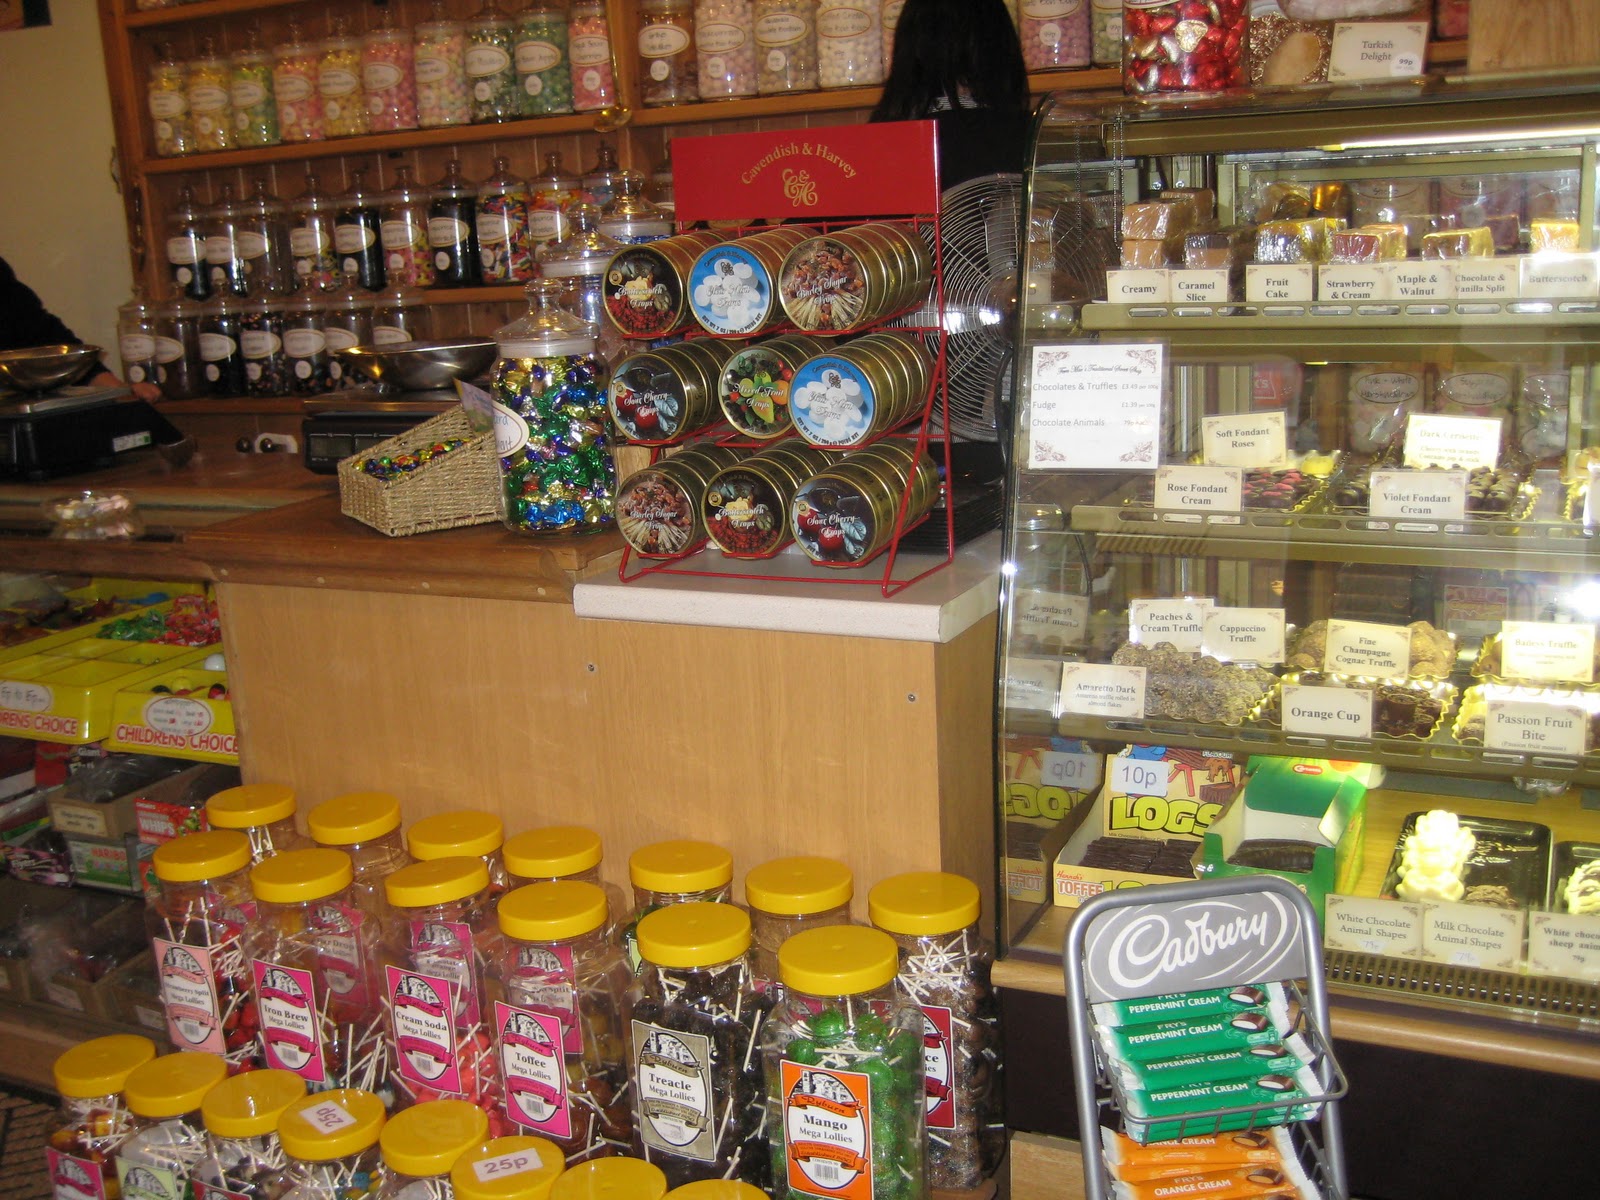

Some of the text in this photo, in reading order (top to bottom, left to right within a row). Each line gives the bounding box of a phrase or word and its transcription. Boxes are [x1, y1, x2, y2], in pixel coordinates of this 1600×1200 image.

[1362, 40, 1393, 49] Turkish
[1360, 51, 1392, 62] Delight
[1398, 58, 1413, 66] 99p
[741, 142, 857, 185] Cavendish & Harvey
[1266, 278, 1288, 287] Fruit
[1397, 275, 1437, 285] Maple &
[1455, 274, 1505, 283] Chocolate &
[1529, 274, 1588, 284] Butterscotch
[617, 284, 664, 297] Butterscotch
[796, 276, 848, 299] Barley Sugar
[1122, 285, 1157, 294] Creamy
[1178, 281, 1215, 290] Caramel
[1326, 280, 1375, 290] Strawberry
[1400, 287, 1435, 295] Walnut
[1455, 284, 1505, 293] Vanilla Split
[1186, 292, 1206, 301] Slice
[1266, 290, 1288, 298] Cake
[1341, 291, 1371, 299] Cream
[629, 298, 654, 309] Drops
[731, 384, 785, 398] Mixed Fruit
[1033, 382, 1076, 391] Chocolates
[1078, 383, 1085, 391] &
[1087, 382, 1117, 391] Truffles
[643, 391, 668, 403] Cherry
[746, 397, 771, 409] Drops
[1032, 401, 1056, 410] Fudge
[1032, 418, 1105, 427] Chocolate Animals
[1216, 428, 1270, 438] Soft Fondant
[1231, 440, 1255, 448] Roses
[1167, 483, 1228, 493] Rose Fondant
[1181, 496, 1212, 505] Cream
[1383, 492, 1451, 503] Violet Fondant
[630, 509, 678, 521] Barley Sugar
[718, 507, 765, 518] Butterscotch
[1400, 505, 1432, 514] Cream
[731, 518, 756, 529] Drops
[828, 513, 857, 524] Cherry
[1150, 612, 1193, 622] Peaches &
[1140, 623, 1203, 633] Cream Truffle
[1219, 624, 1266, 634] Cappuccino
[1228, 634, 1257, 643] Truffle
[1358, 637, 1377, 646] Fine
[1548, 640, 1577, 649] Truffle
[1342, 645, 1391, 658] Champagne
[1335, 655, 1397, 669] Cognac Truffle
[1076, 682, 1136, 694] Amaretto Dark
[1291, 706, 1361, 723] Orange Cup
[34, 714, 78, 736] CHOICE
[1497, 713, 1573, 729] Passion Fruit
[117, 725, 239, 754] CHILDRENS CHOICE
[1522, 729, 1546, 741] Bite
[1122, 766, 1157, 789] 10p
[1109, 796, 1224, 837] LOGS
[140, 818, 175, 836] WHIPS
[1057, 879, 1104, 896] TOFFEE
[1336, 912, 1411, 929] White Chocolate
[1340, 924, 1407, 940] Animal Shapes
[1434, 920, 1504, 938] Milk Chocolate
[1544, 927, 1570, 938] White
[1434, 933, 1502, 950] Animal Shapes
[1549, 938, 1574, 949] sheep
[1108, 911, 1268, 988] Cadbury
[185, 996, 205, 1006] Lollies
[1128, 995, 1221, 1014] PEPPERMINT CREAM
[264, 1004, 309, 1023] Iron Brew
[268, 1015, 305, 1030] Mega Lollies
[396, 1010, 447, 1031] Cream Soda
[402, 1023, 441, 1040] Mega Lollies
[1128, 1023, 1223, 1045] PEPPERMINT CREAM
[515, 1051, 546, 1069] Toffee
[1146, 1051, 1242, 1071] PEPPERMINT CREAM
[512, 1063, 551, 1081] Mega Lollies
[649, 1072, 692, 1091] Treacle
[649, 1084, 696, 1103] Mega Lollies
[1150, 1088, 1211, 1102] PEPPERMINT
[1213, 1082, 1248, 1095] CREAM
[801, 1095, 845, 1114] Ryburn
[316, 1106, 344, 1128] 25p
[803, 1113, 848, 1131] Mango
[799, 1127, 853, 1144] Mega Lollies
[1181, 1136, 1216, 1147] CREAM
[483, 1156, 529, 1174] 25p
[1154, 1179, 1232, 1197] ORANGE CREAM
